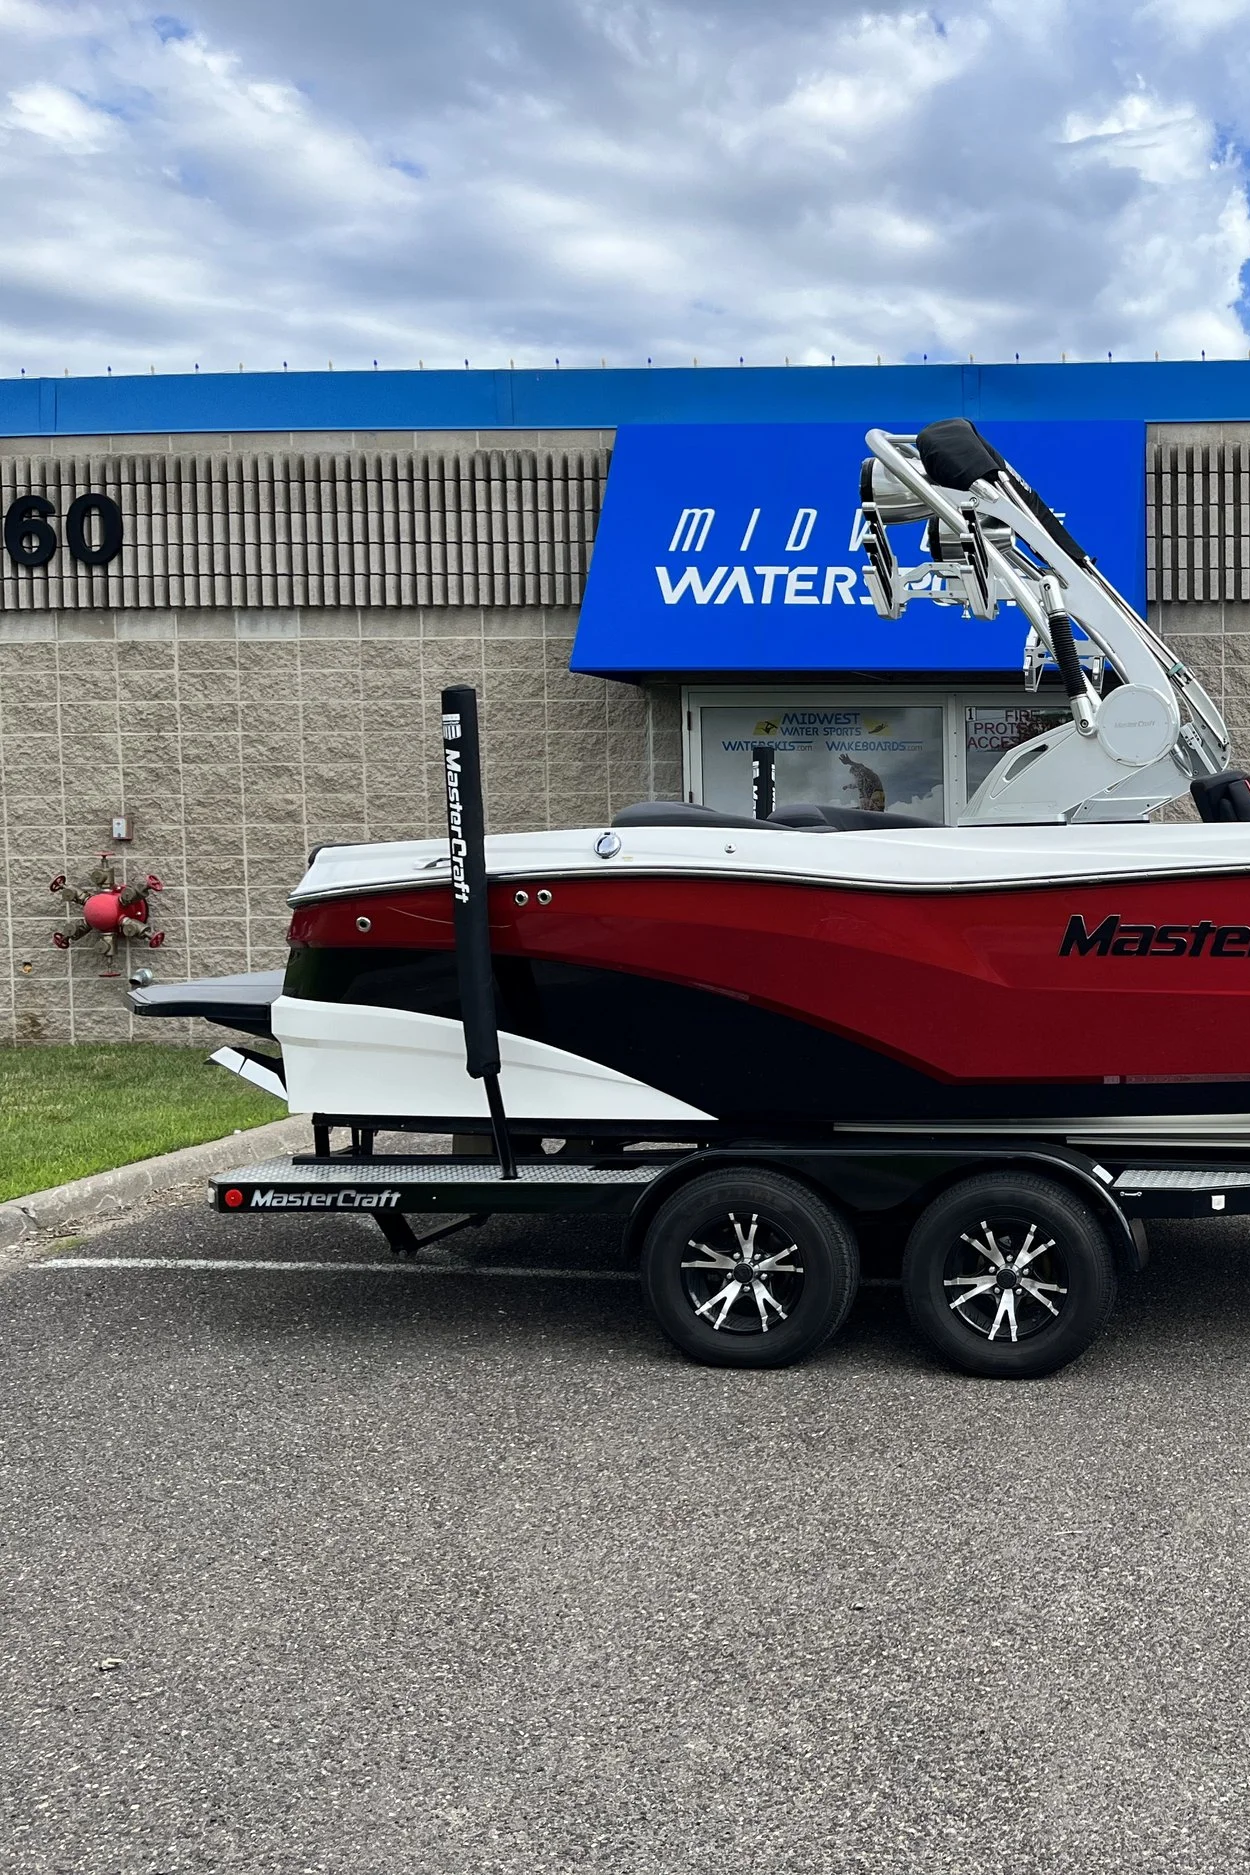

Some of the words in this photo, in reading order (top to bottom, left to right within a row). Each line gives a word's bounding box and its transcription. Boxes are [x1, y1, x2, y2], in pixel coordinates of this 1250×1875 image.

[5, 493, 123, 567] 60
[781, 712, 861, 725] MIDWEST
[967, 708, 974, 720] 1
[1005, 710, 1040, 721] FIRE
[781, 727, 819, 736] WATER
[823, 727, 861, 736] SPORTS
[445, 749, 470, 904] MasterCraft
[250, 1189, 402, 1208] MasterCraft
